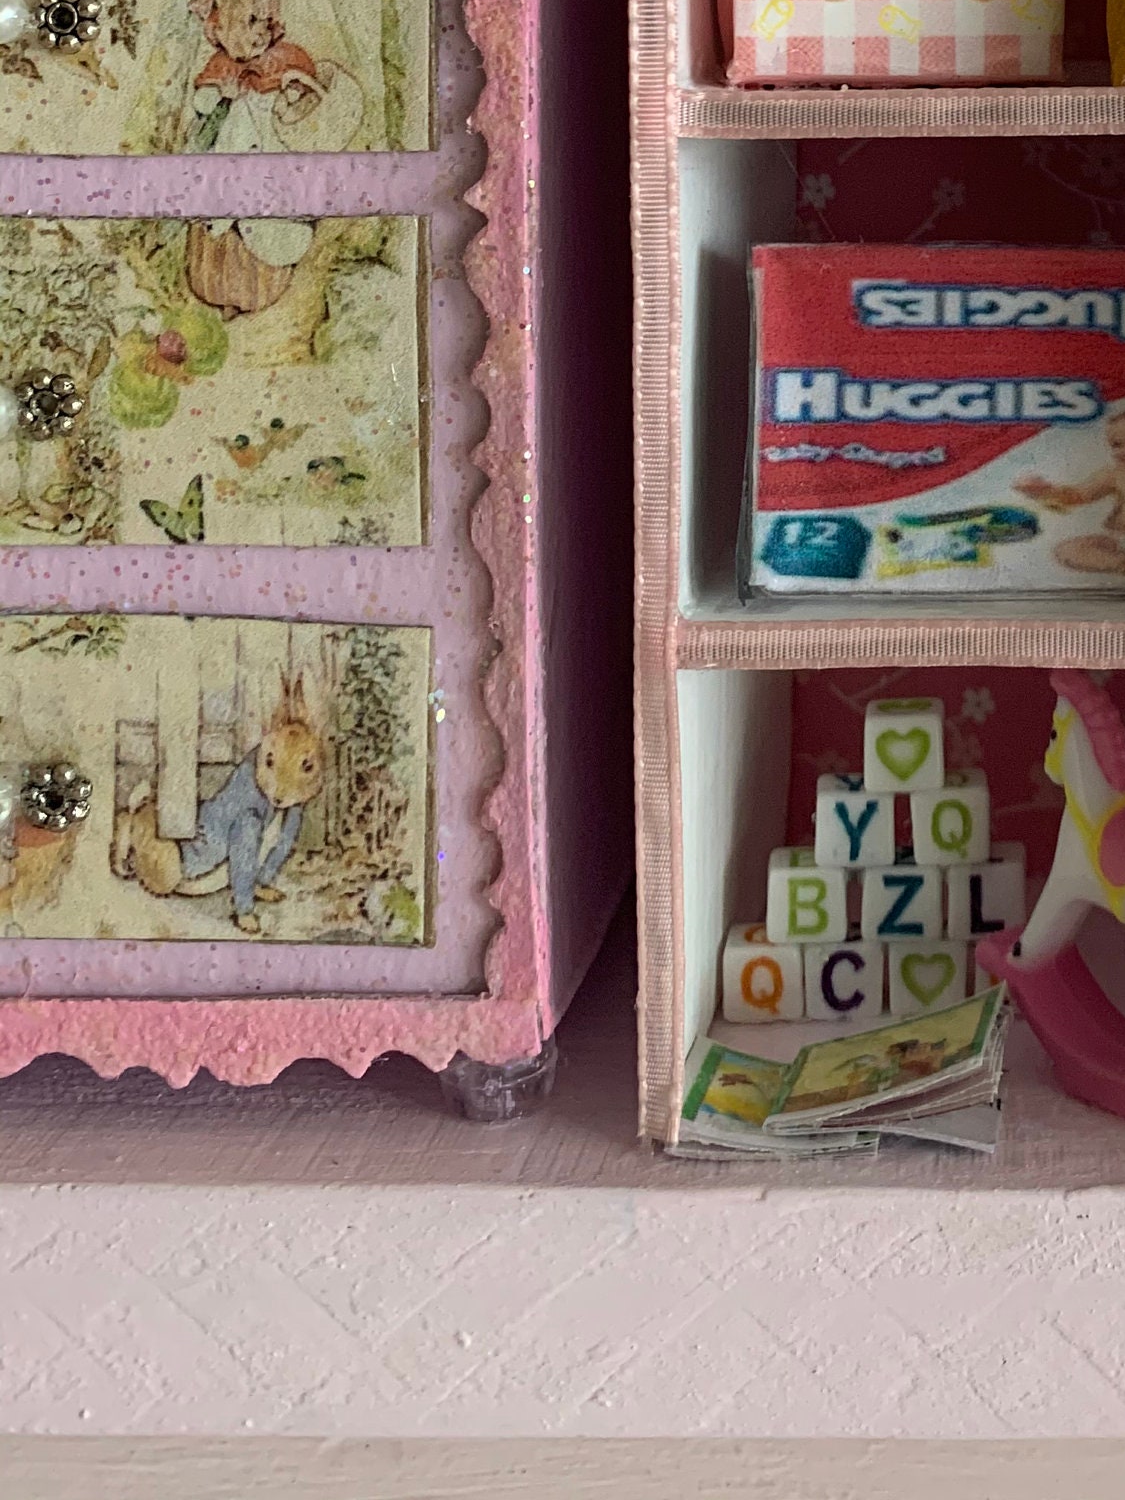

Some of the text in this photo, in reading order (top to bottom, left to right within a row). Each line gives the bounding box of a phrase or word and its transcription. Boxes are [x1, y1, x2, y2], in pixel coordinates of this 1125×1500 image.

[772, 368, 1101, 423] HUGGIES
[834, 799, 973, 862] Y Q
[787, 874, 1006, 936] B Z L
[740, 950, 866, 1015] Q C
